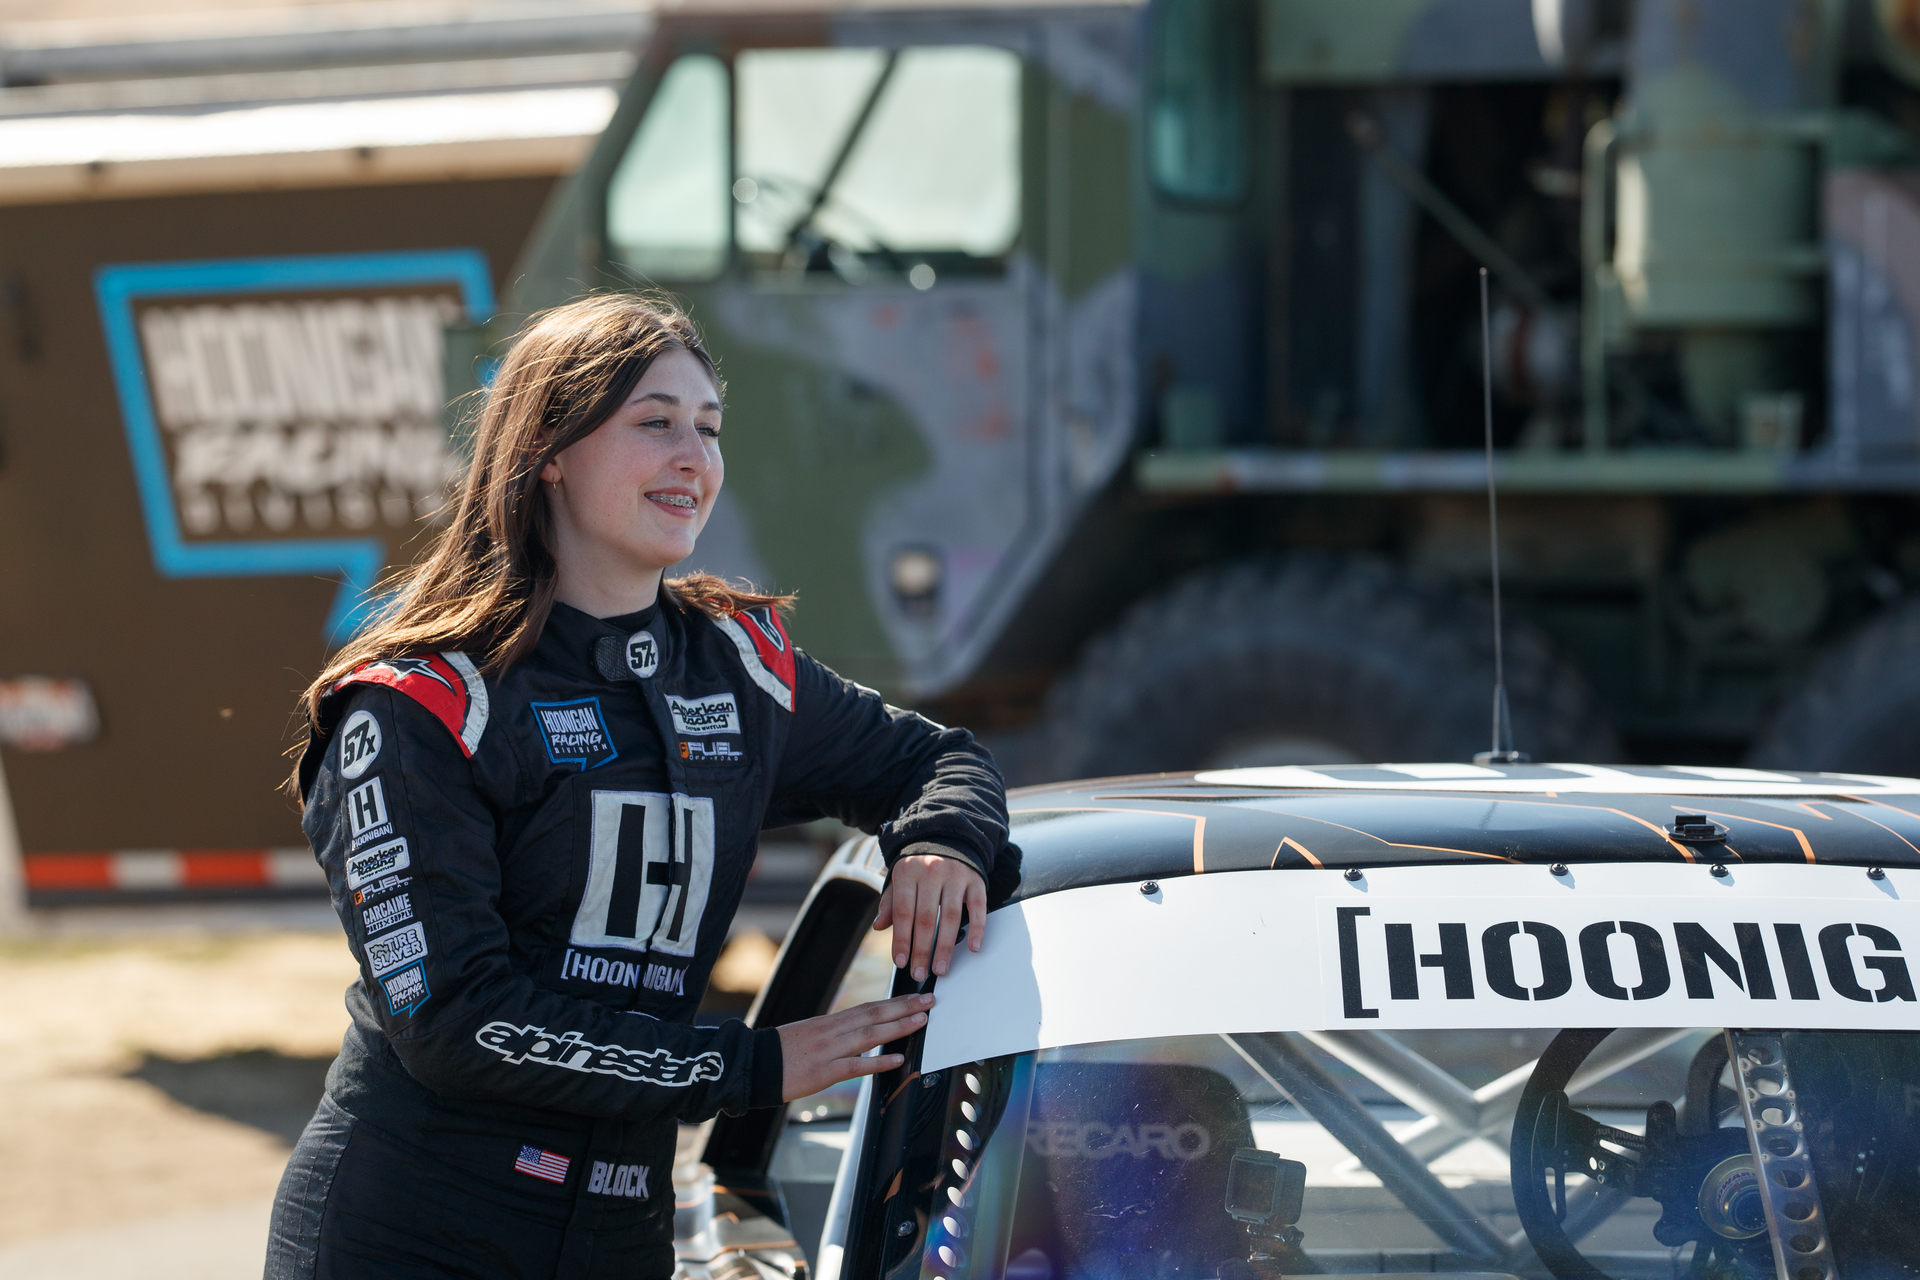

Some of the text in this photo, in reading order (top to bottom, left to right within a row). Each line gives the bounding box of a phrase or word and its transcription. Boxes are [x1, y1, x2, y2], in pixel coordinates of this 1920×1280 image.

[540, 707, 599, 733] HOONIGAN
[551, 731, 602, 746] RACING
[554, 743, 608, 754] DIVISION
[351, 845, 404, 872] American
[357, 857, 396, 877] Racing
[363, 893, 411, 925] CARCAINE
[384, 928, 417, 951] TIRE
[374, 941, 423, 971] SLAYER
[385, 966, 422, 997] HOONIGAN
[1026, 1121, 1211, 1160] RECARO
[587, 1160, 650, 1199] BLOCK
